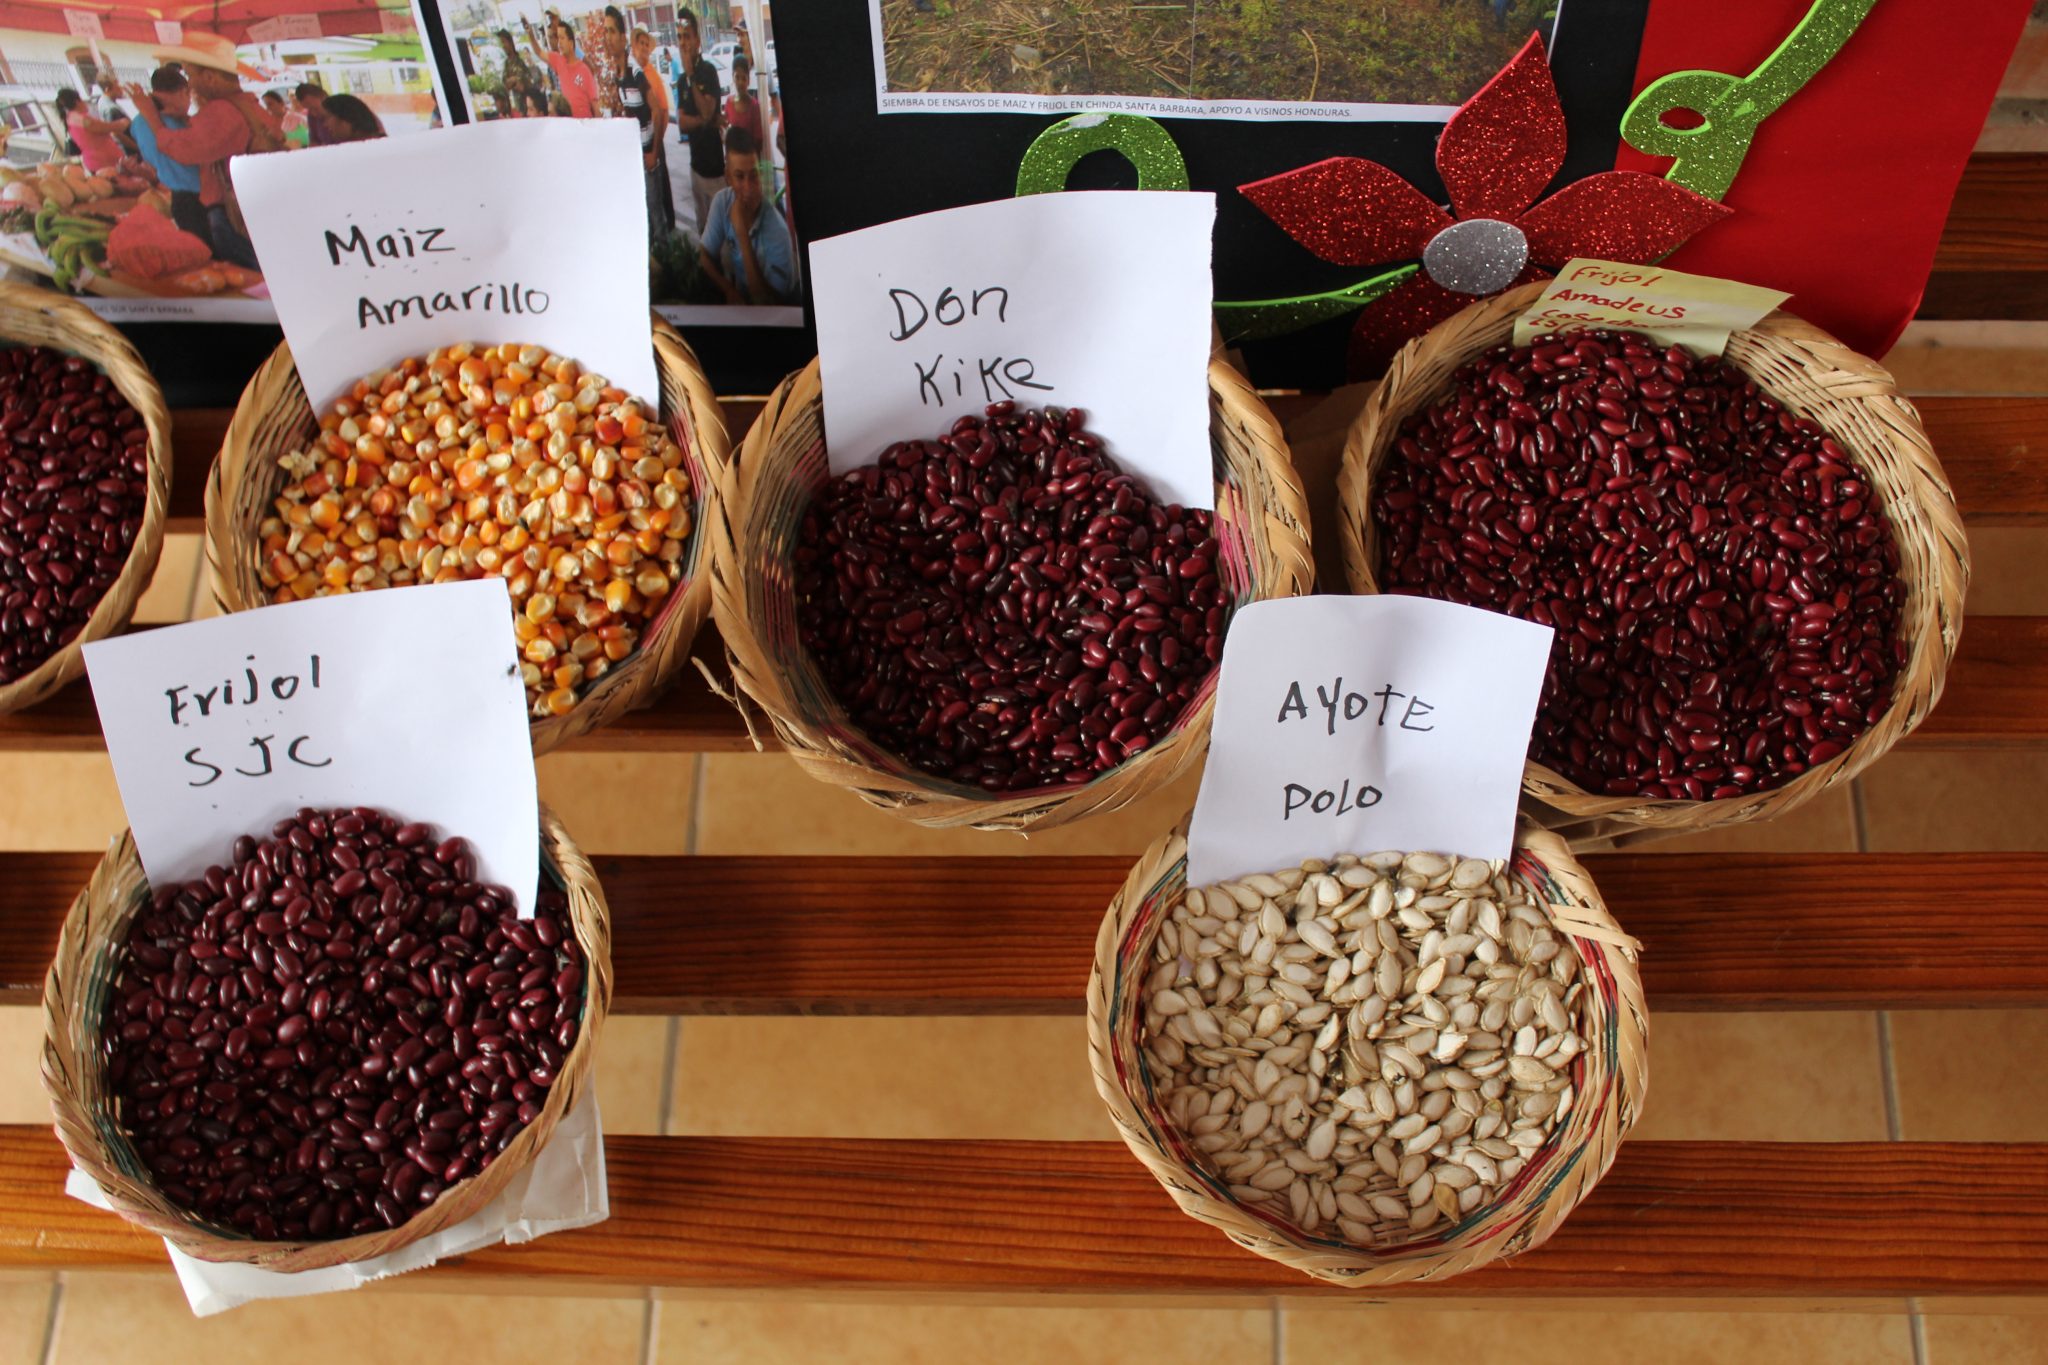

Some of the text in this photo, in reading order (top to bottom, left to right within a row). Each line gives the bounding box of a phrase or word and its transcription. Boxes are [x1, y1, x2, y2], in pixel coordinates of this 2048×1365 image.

[882, 98, 1353, 118] SIEMBRA DE ENSAYOS DE MAIZ Y FRIJOL EN CHINDA SANTA BARBARA, APOYO A VISINOS HONDURAS.
[325, 225, 454, 267] Maiz
[1570, 266, 1663, 287] Frijol
[359, 283, 549, 328] Amarillo
[889, 286, 1008, 341] Don
[914, 354, 1054, 408] Kike
[166, 655, 320, 724] Frijol
[1278, 677, 1434, 736] AYOTE
[184, 735, 332, 787] SJC
